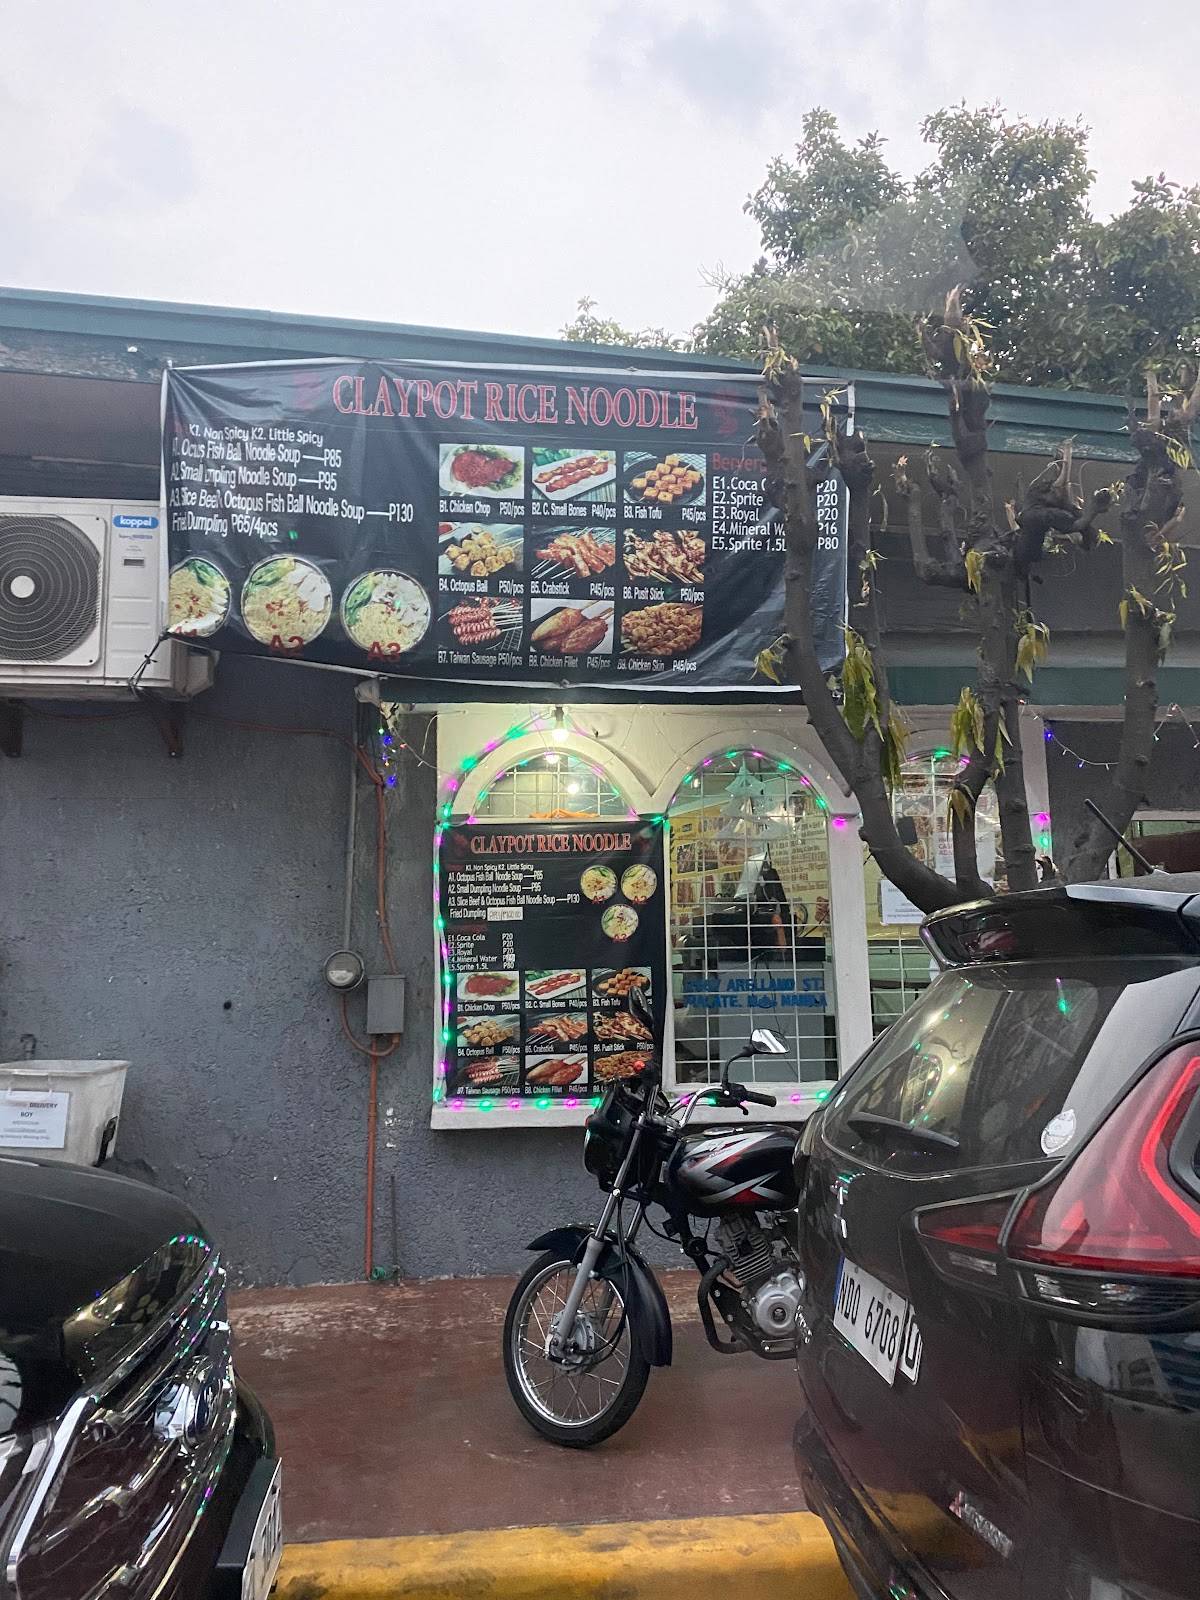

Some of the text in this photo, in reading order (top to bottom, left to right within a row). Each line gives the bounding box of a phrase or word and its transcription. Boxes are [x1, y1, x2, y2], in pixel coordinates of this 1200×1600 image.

[332, 375, 699, 430] CLAYPOT RICE NOODLE
[203, 426, 224, 440] Non
[224, 426, 249, 441] Spicy
[251, 427, 267, 441] K2.
[269, 427, 295, 442] Little
[296, 430, 324, 447] Spicy
[206, 440, 225, 460] Fish
[245, 441, 276, 461] Noodle
[277, 443, 300, 468] Soup
[180, 461, 204, 481] Small
[238, 466, 270, 485] Noodle
[272, 466, 297, 491] Soup
[224, 490, 263, 514] Octopus
[265, 492, 285, 513] Fish
[287, 493, 304, 513] Ball
[306, 495, 339, 517] Noodle
[340, 499, 365, 525] Soup
[449, 500, 474, 513] Chicken
[474, 501, 491, 517] Chop
[499, 500, 525, 518] P50/pcs
[816, 493, 838, 507] P20
[550, 502, 568, 516] Small
[568, 503, 587, 517] Bones
[591, 503, 617, 520] P40/pcs
[635, 505, 648, 519] Fish
[648, 506, 662, 519] Tofu
[681, 507, 707, 523] P45/pcs
[817, 508, 839, 521] P20
[120, 516, 152, 527] koppel
[187, 511, 278, 538] Dumpling P65/4pcs
[765, 538, 787, 552] 1.5L
[817, 537, 839, 550] P80
[449, 578, 475, 595] Octopus
[476, 579, 489, 593] Ball
[498, 579, 524, 596] P50/pcs
[541, 581, 570, 595] Crabstick
[590, 582, 615, 599] P45/pcs
[633, 586, 649, 600] Pusit
[649, 587, 665, 600] Stick
[680, 587, 705, 604] P50/pcs
[270, 634, 304, 655] A2
[367, 641, 401, 662] A3
[449, 650, 471, 664] Taiwan
[471, 651, 497, 667] Sausage
[498, 652, 523, 668] P50/pcs
[539, 655, 563, 668] Chicken
[586, 655, 611, 669] P45/pcs
[628, 658, 652, 671] Chicken
[652, 659, 665, 672] Skin
[672, 658, 697, 674] P45/pcs
[470, 832, 632, 854] CLAYPOT RICE NOODLE
[484, 863, 498, 872] Spicy
[520, 862, 534, 871] Spicy
[456, 871, 475, 883] Octopus
[475, 871, 485, 882] Fish
[485, 871, 494, 881] Ball
[495, 871, 511, 881] Noodle
[511, 870, 524, 882] Soup
[456, 884, 469, 894] Small
[469, 883, 492, 895] Dumpling
[492, 883, 509, 893] Noodle
[509, 882, 521, 894] Soup
[468, 896, 481, 906] Beef
[485, 895, 506, 908] Octopus
[505, 895, 517, 905] Fish
[516, 895, 526, 905] Ball
[525, 894, 543, 905] Noodle
[543, 894, 556, 906] Soup
[449, 908, 463, 919] Fried
[463, 908, 486, 919] Dumpling
[464, 1003, 483, 1012] Chicken
[483, 1003, 496, 1013] Chop
[539, 1000, 551, 1008] Small
[551, 1000, 566, 1008] Bones
[838, 1271, 861, 1325] NDO
[865, 1296, 900, 1361] 6708
